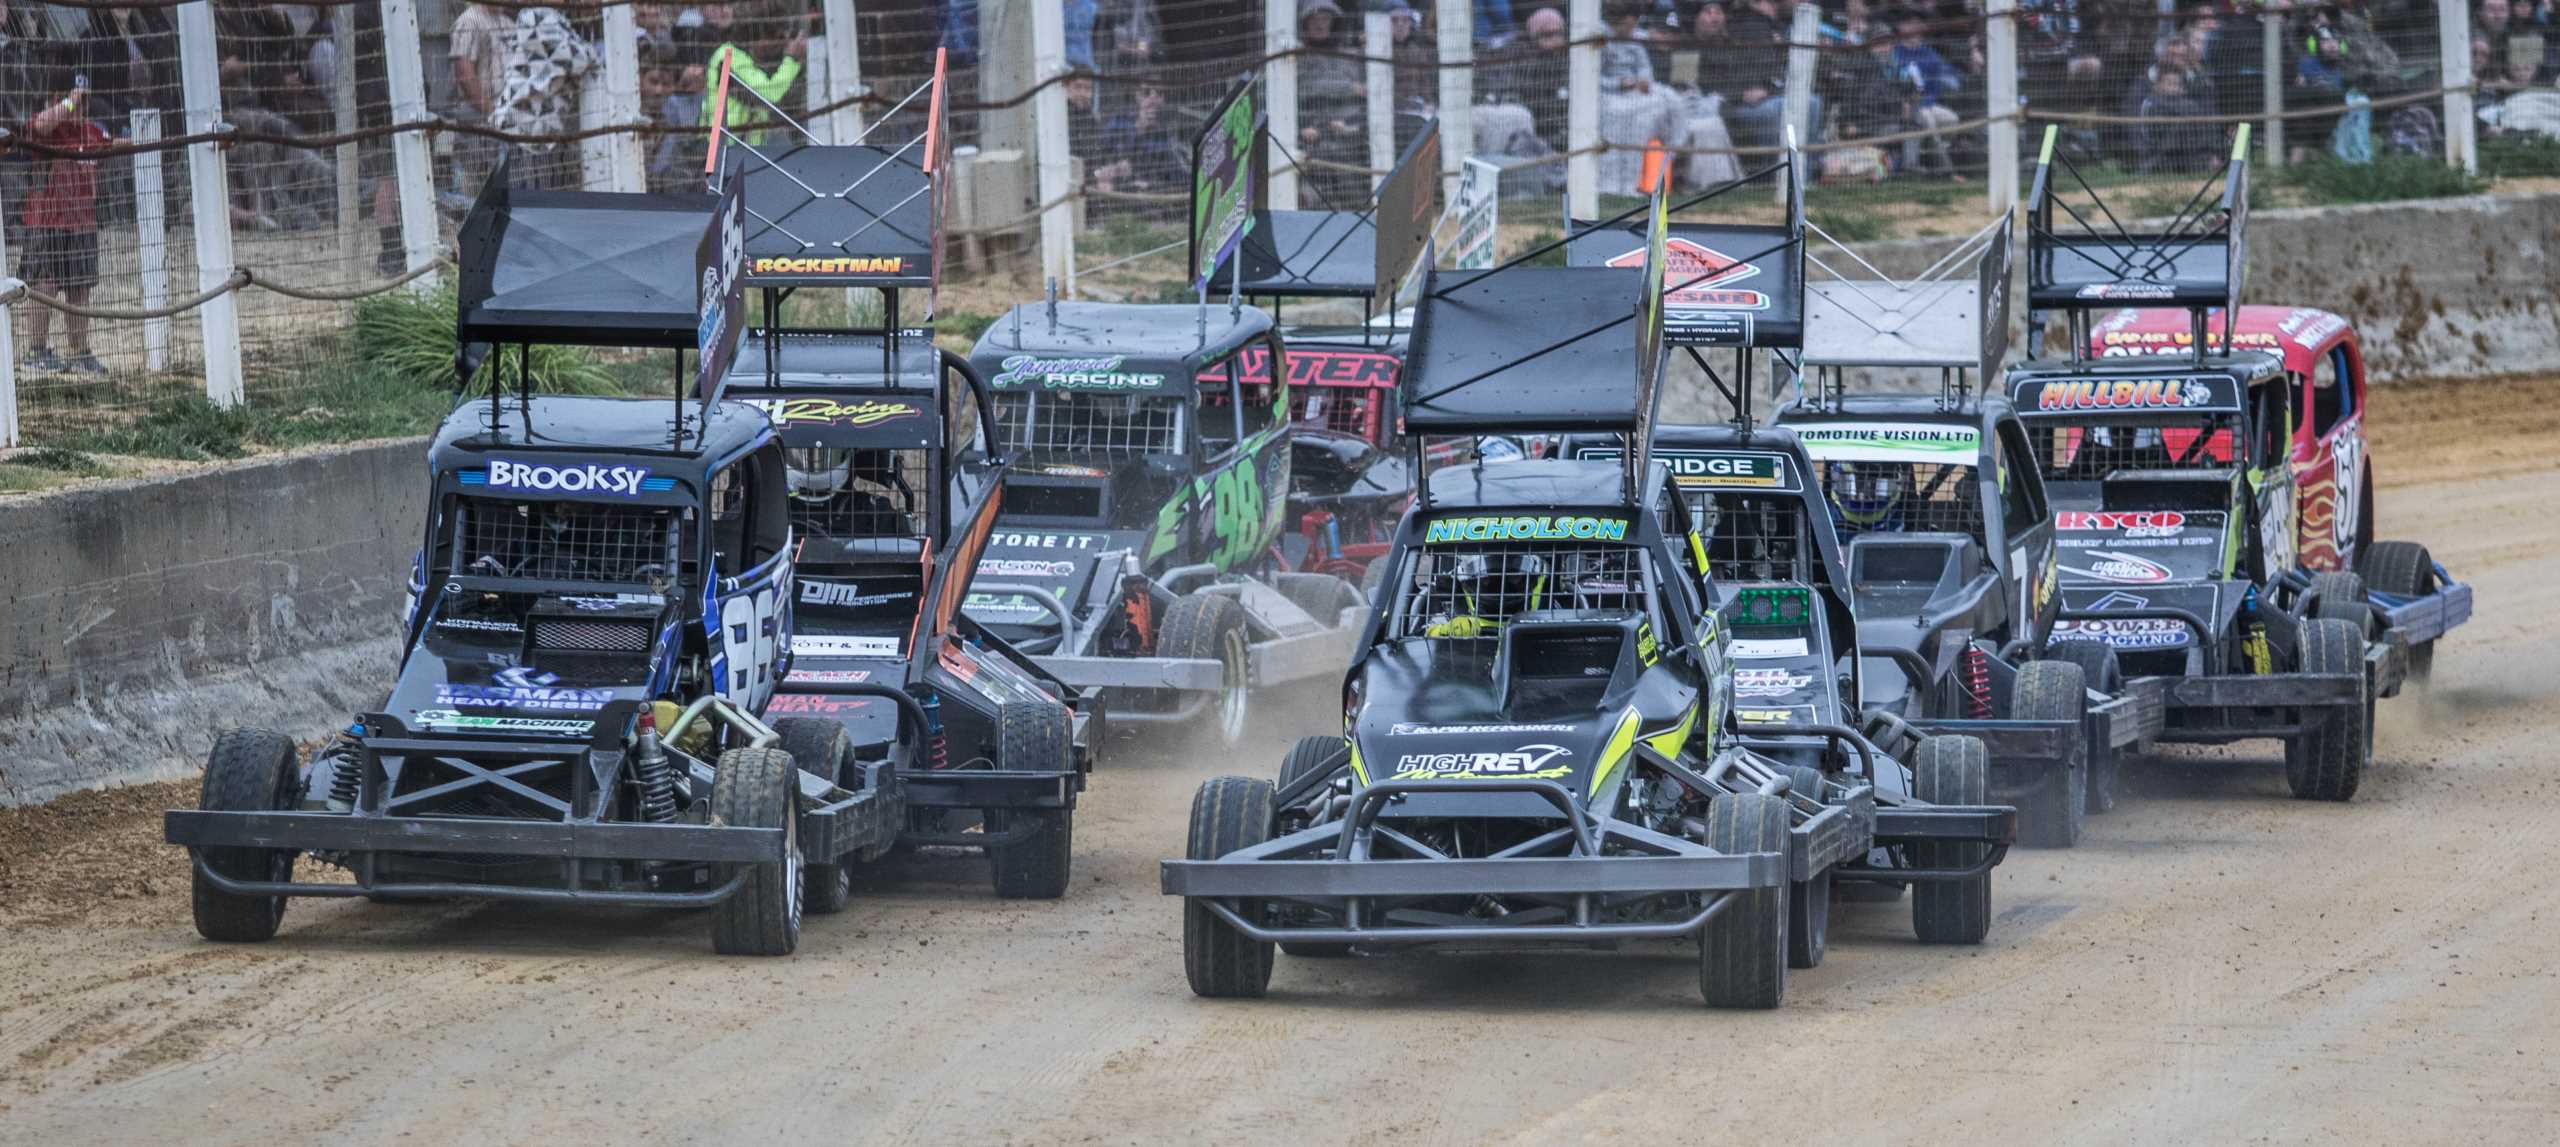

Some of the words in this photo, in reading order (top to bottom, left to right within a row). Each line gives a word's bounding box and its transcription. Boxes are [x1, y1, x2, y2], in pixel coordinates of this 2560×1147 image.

[756, 257, 902, 273] ROCKETMAN
[1046, 373, 1160, 386] RACING
[2040, 380, 2184, 411] HILLBILL
[783, 399, 916, 424] Racing
[489, 461, 646, 495] BROOKSY
[1425, 517, 1628, 543] NICHOLSON
[2056, 512, 2186, 530] RYCO
[991, 533, 1058, 548] TORE
[1065, 535, 1092, 549] IT
[436, 696, 519, 707] HEAVY
[496, 718, 592, 729] MACHINE
[1396, 746, 1567, 773] HIGHREV
